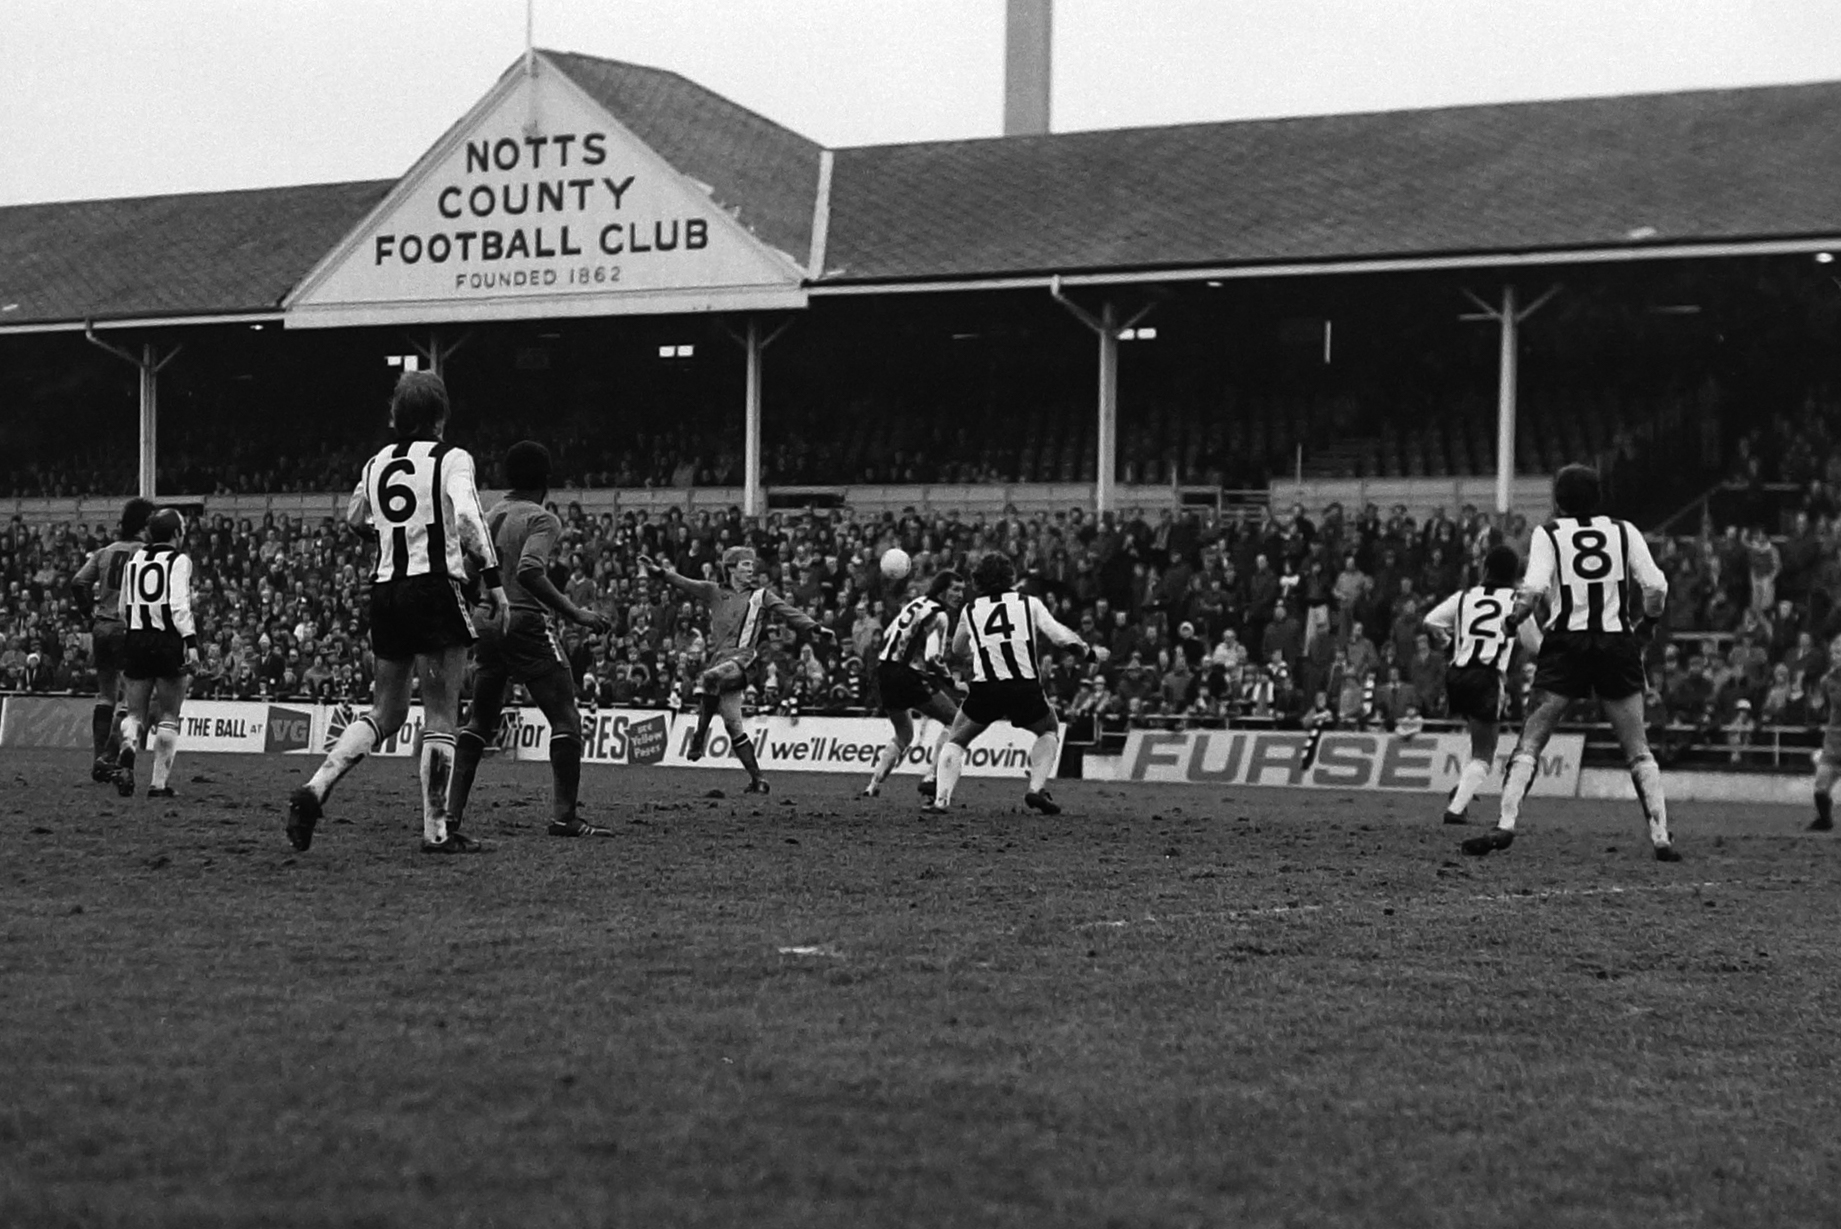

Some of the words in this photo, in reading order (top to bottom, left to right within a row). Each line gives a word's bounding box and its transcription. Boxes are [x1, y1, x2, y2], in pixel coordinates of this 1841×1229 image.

[467, 132, 606, 173] NOTTS
[438, 176, 635, 218] COUNTY
[375, 225, 582, 265] FOOTBALL
[599, 218, 709, 255] CLUB
[456, 269, 557, 288] FOUNDED
[570, 266, 621, 285] 1862
[377, 458, 417, 523] 6
[1572, 530, 1613, 580] 8
[130, 562, 165, 603] 10
[984, 602, 1015, 640] 4
[1469, 599, 1502, 638] 2
[187, 717, 212, 737] THE
[215, 718, 247, 738] BALL
[250, 723, 264, 734] AT
[270, 719, 309, 742] VG
[630, 730, 664, 747] Yellow
[679, 726, 768, 758] Moil
[771, 737, 827, 760] we'll
[964, 741, 1031, 768] ovin
[633, 744, 661, 759] Pages
[1130, 733, 1439, 788] FURSE
